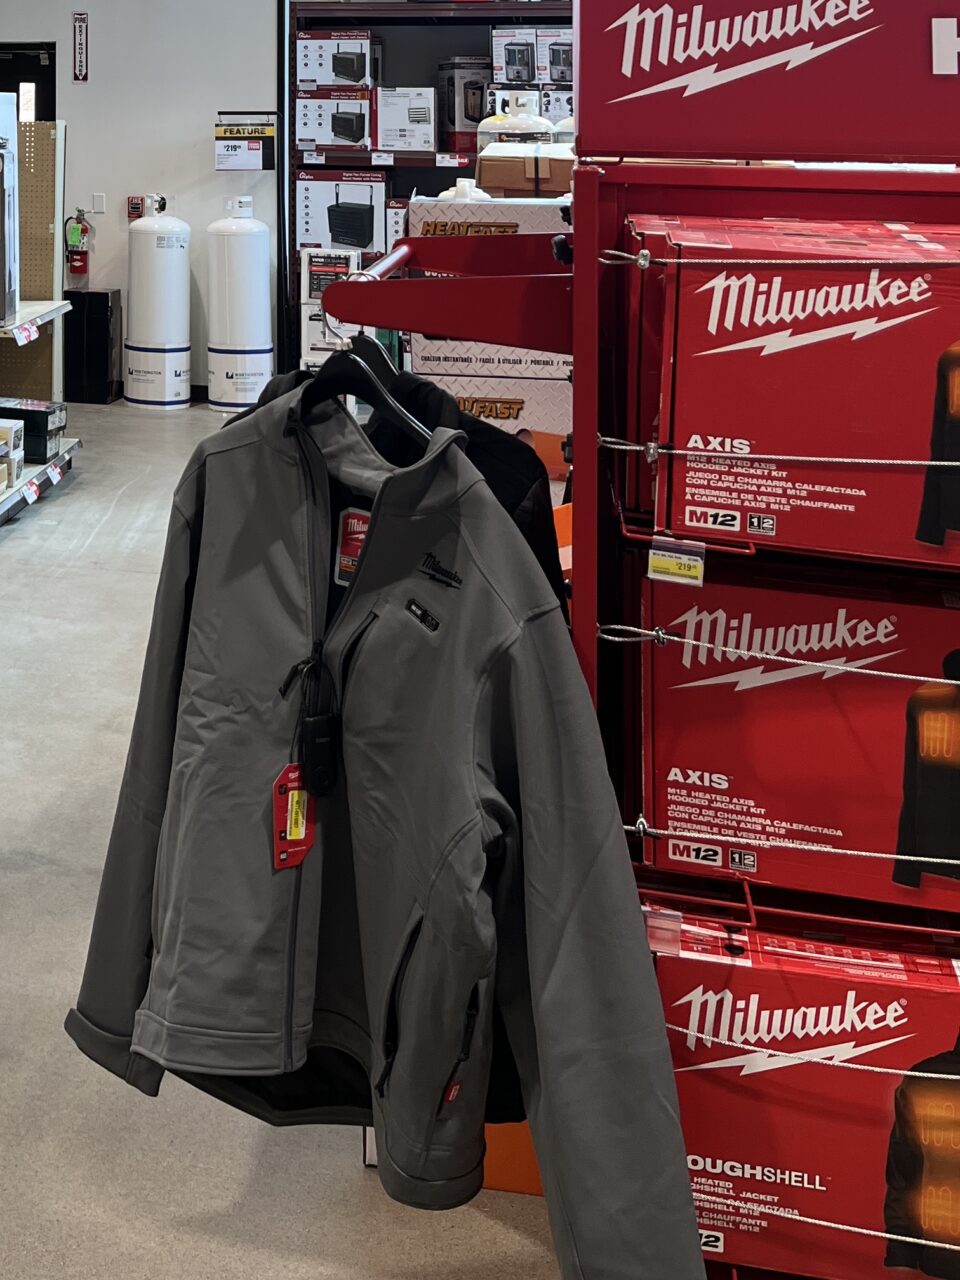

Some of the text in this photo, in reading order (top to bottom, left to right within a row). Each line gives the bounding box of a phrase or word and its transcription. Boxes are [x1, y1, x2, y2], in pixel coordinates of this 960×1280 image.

[223, 127, 267, 135] FEATURE
[694, 268, 933, 336] Milwaukee
[456, 396, 525, 419] ATFAST
[686, 434, 751, 454] AXIS
[686, 461, 788, 478] HOODED JACKET KIT
[711, 456, 751, 468] HEATED
[753, 461, 777, 470] AXIS
[685, 471, 867, 496] JUEGO DE CHAMARRA CALEFACTADA
[685, 477, 808, 497] CON CAPUCHA AXIS M12
[685, 486, 856, 512] ENSEMBLE DE VESTE CHAUFFANTE
[693, 495, 742, 506] CAPUCHE
[743, 499, 767, 509] AXIS
[769, 503, 791, 512] M12
[688, 509, 738, 528] M12
[666, 605, 899, 671] Milwaukee
[666, 766, 730, 790] AXIS
[667, 787, 755, 807] M12 HEATED AXIS
[667, 794, 766, 815] HOODED JACKET KIT
[667, 804, 843, 837] JUEGO DE CHAMARRA CALEFACTADA
[667, 810, 787, 835] CON CAPUCHA AXIS M12
[667, 820, 720, 835] ENSEMBLE
[721, 827, 735, 837] DE
[736, 830, 767, 842] VESTE
[671, 843, 719, 863] M12
[670, 984, 909, 1051] Milwaukee
[686, 1154, 827, 1191] OUGHSHELL
[693, 1176, 734, 1189] HEATED
[690, 1183, 736, 1196] GHSHELL
[739, 1191, 780, 1203] JACKET
[693, 1200, 736, 1213] HSHELL
[696, 1217, 761, 1233] HSHELL M12
[701, 1211, 768, 1228] CHAUFFANTE
